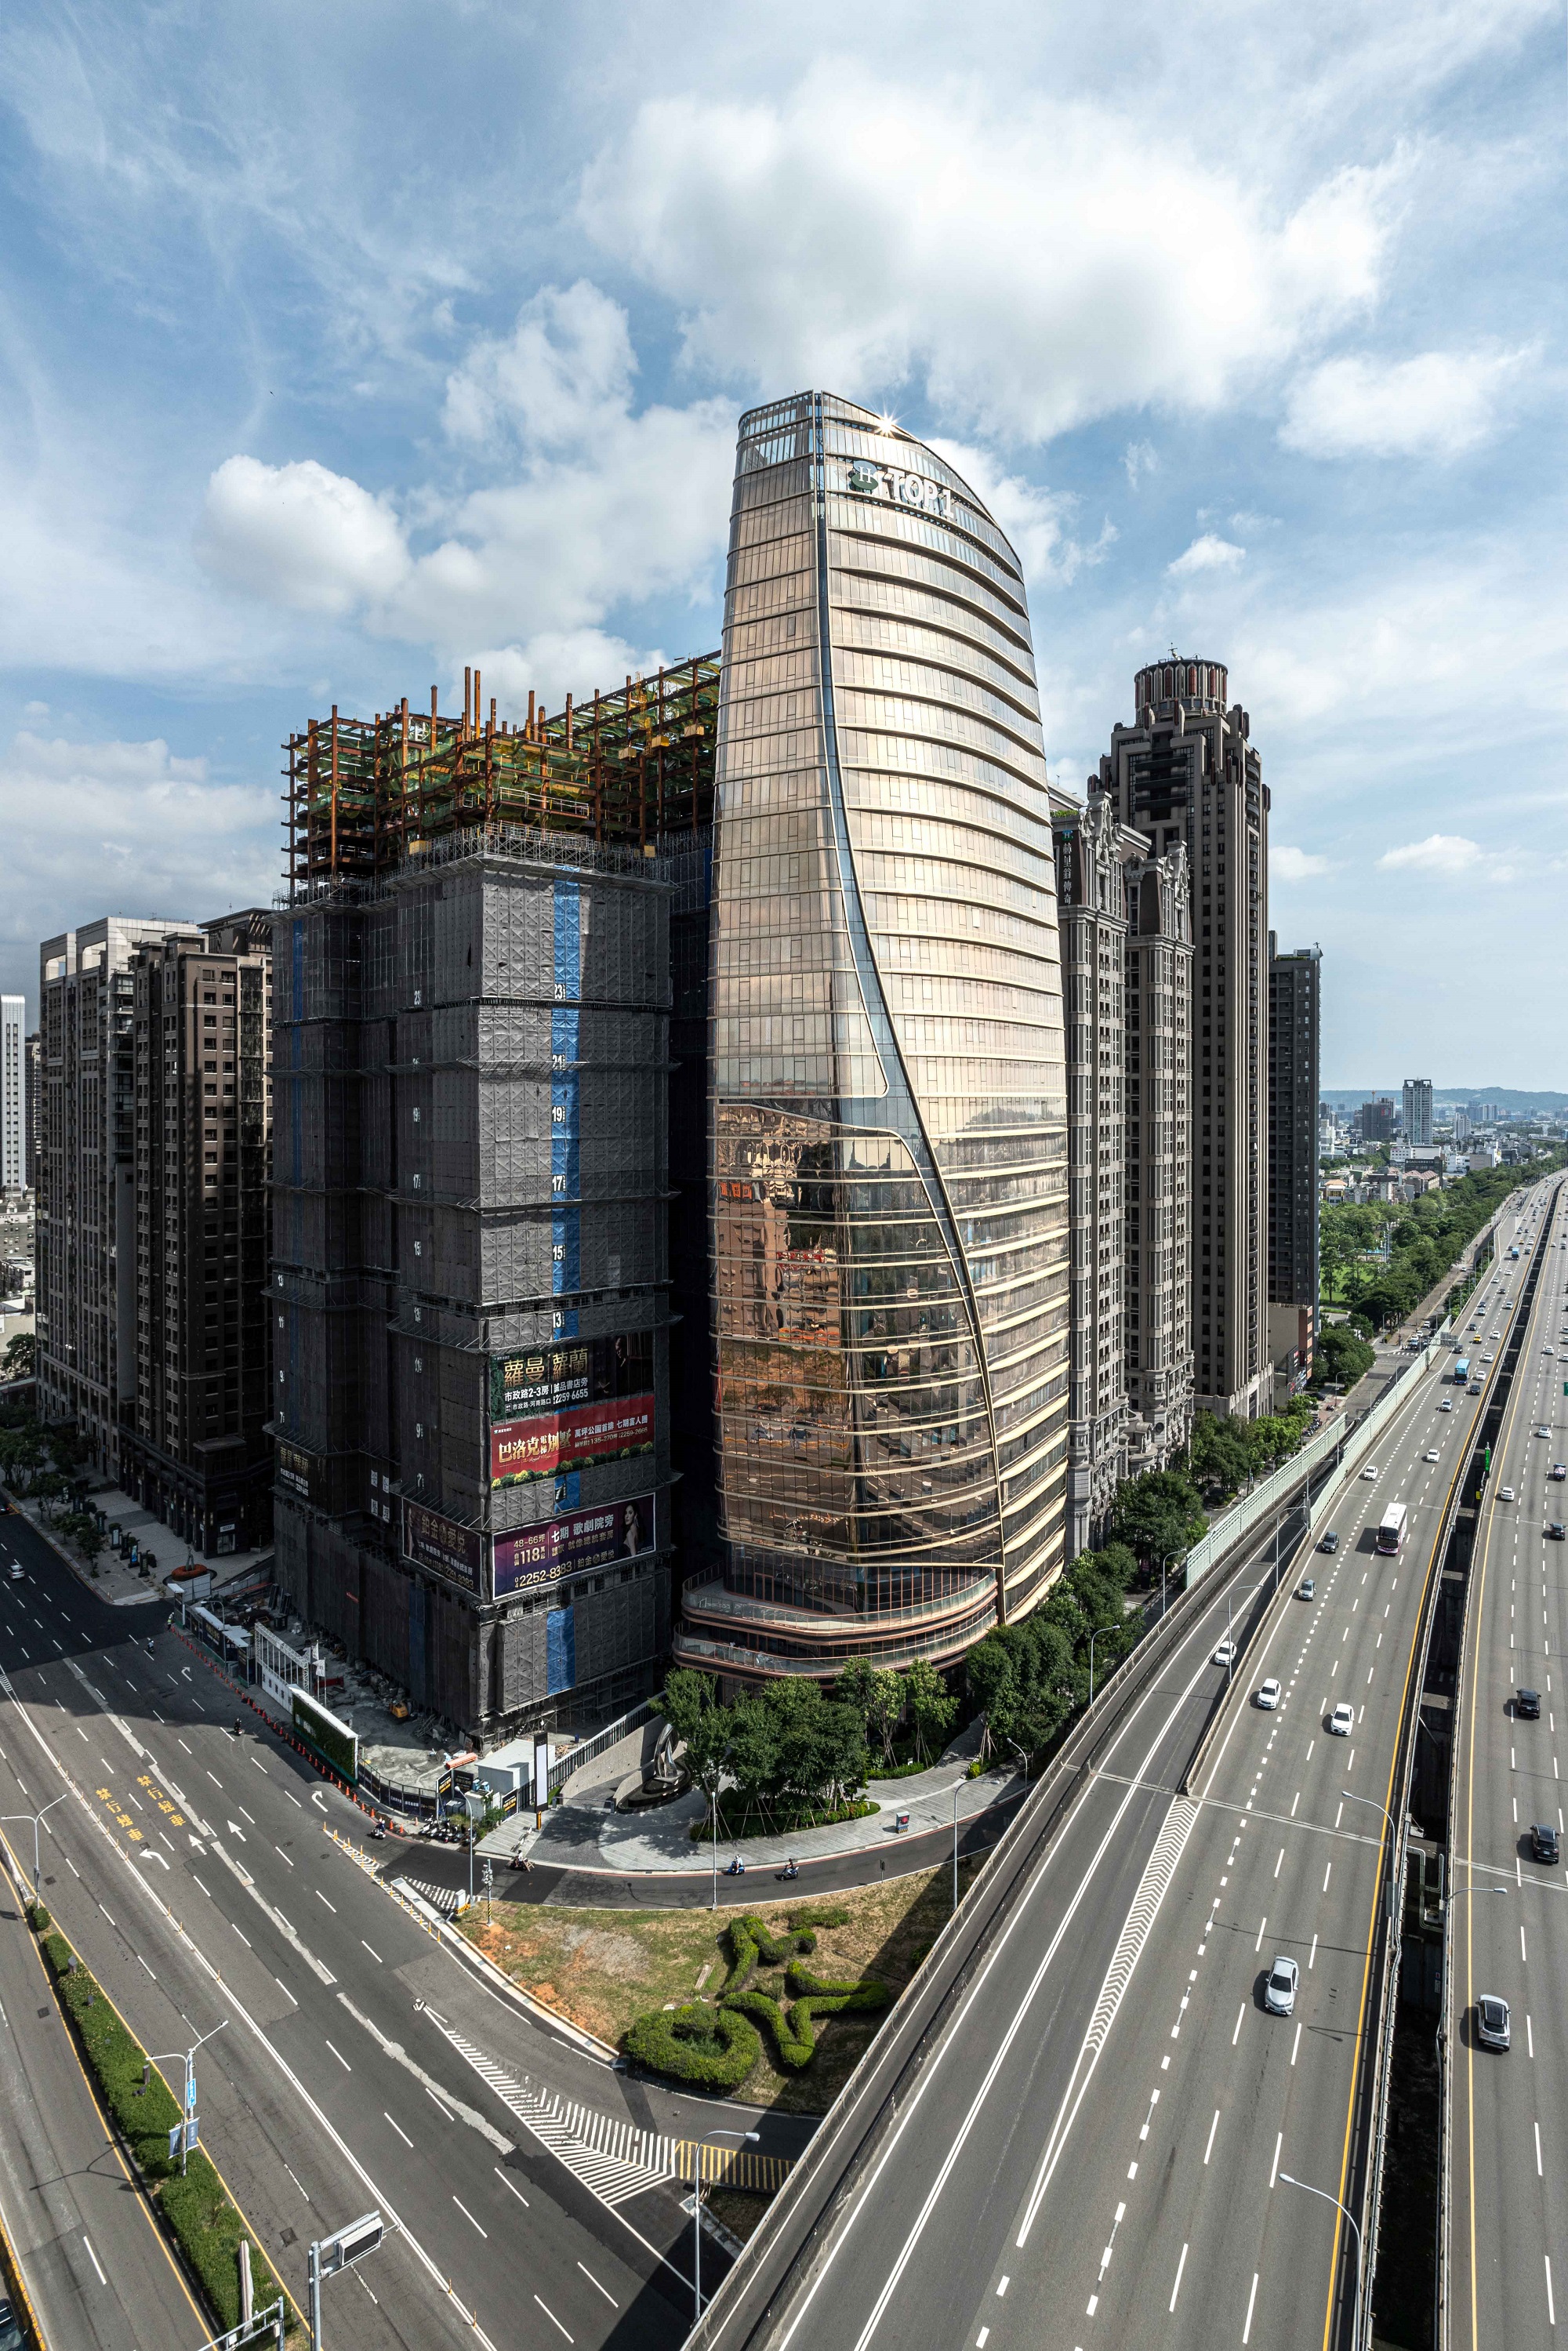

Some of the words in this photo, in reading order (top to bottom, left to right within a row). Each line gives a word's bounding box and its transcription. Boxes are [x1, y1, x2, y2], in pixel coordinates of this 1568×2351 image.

[554, 984, 562, 999] 23
[553, 1107, 562, 1121] 19
[553, 1176, 562, 1191] 17
[554, 1245, 562, 1260] 15
[554, 1312, 561, 1328] 13
[499, 1436, 539, 1463] 巴洛克
[551, 1526, 568, 1544] 七期
[521, 1547, 539, 1565] 118
[520, 1561, 572, 1587] 2252-8383
